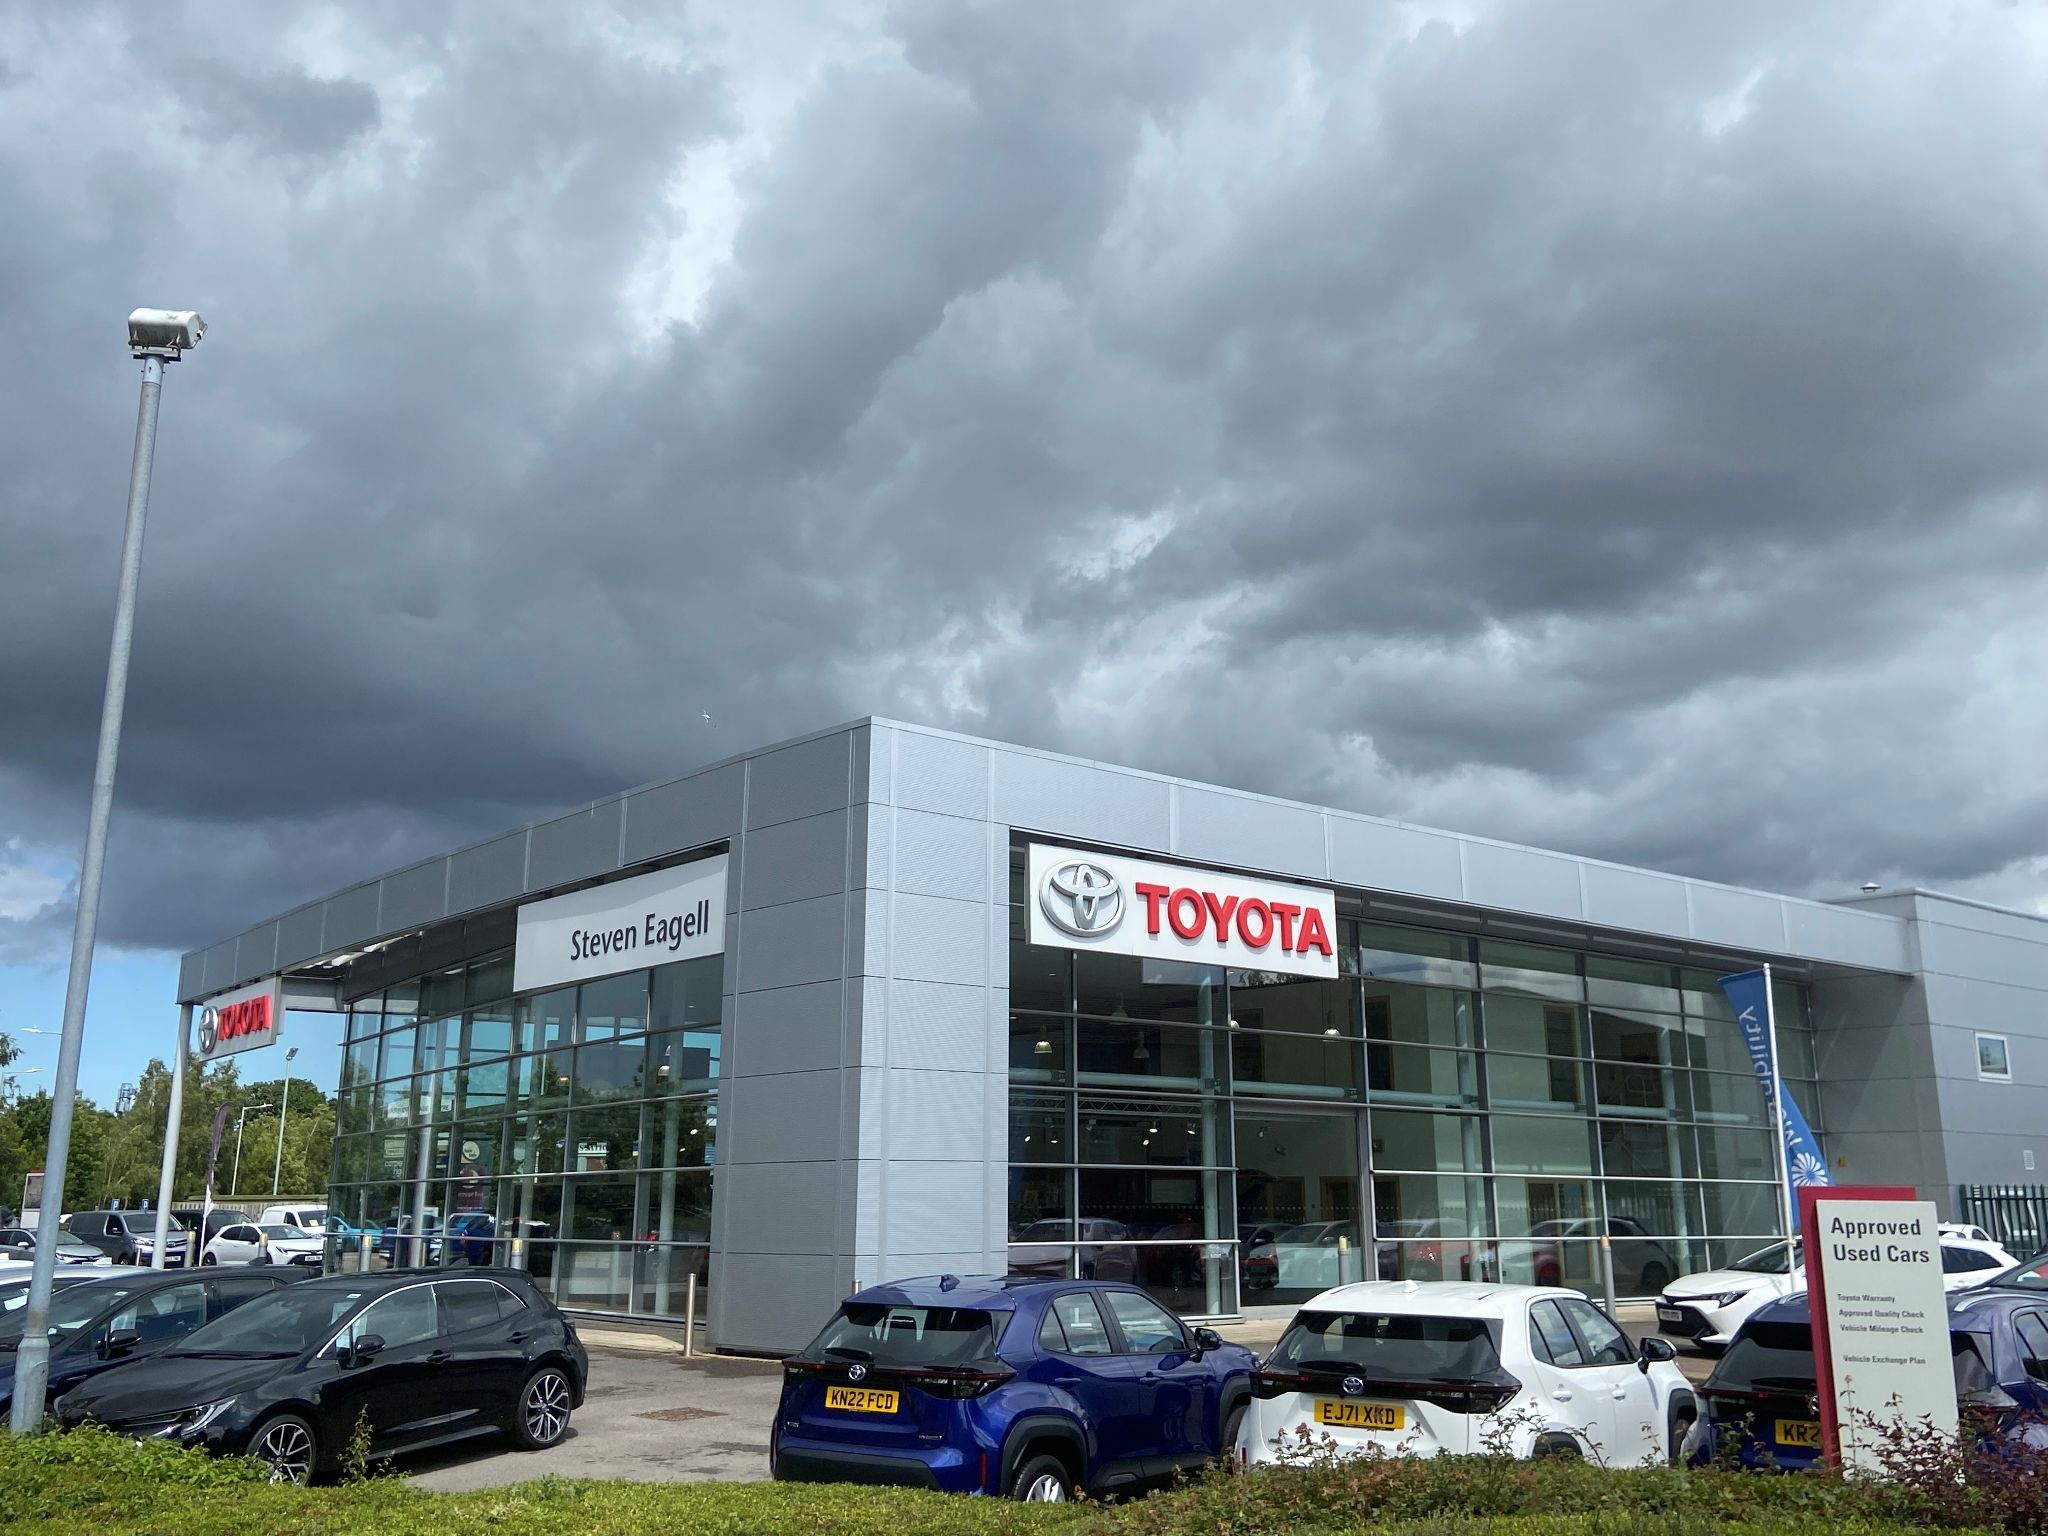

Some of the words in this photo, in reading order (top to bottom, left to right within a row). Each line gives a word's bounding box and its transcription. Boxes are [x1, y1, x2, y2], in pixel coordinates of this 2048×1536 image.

[1135, 881, 1333, 957] TOYOTA
[570, 924, 637, 961] Steven
[644, 899, 709, 951] Eagell
[218, 994, 271, 1041] TOYOTA
[1831, 1217, 1921, 1239] Approved
[1833, 1244, 1881, 1261] Used
[1887, 1245, 1930, 1263] Cars
[1837, 1293, 1861, 1302] Toyota
[1862, 1294, 1896, 1303] Warranty
[1839, 1309, 1873, 1318] Approved
[1874, 1310, 1900, 1319] Quality
[1901, 1310, 1925, 1318] Check
[1840, 1324, 1867, 1332] Vehicle
[1869, 1325, 1899, 1334] Mileage
[1901, 1326, 1924, 1334] Check
[1843, 1354, 1871, 1363] Vehicle
[1872, 1355, 1907, 1365] Exchange
[1909, 1356, 1926, 1364] Plan
[831, 1389, 865, 1408] KN22
[867, 1393, 893, 1410] FCD
[1323, 1403, 1359, 1422] EJ71
